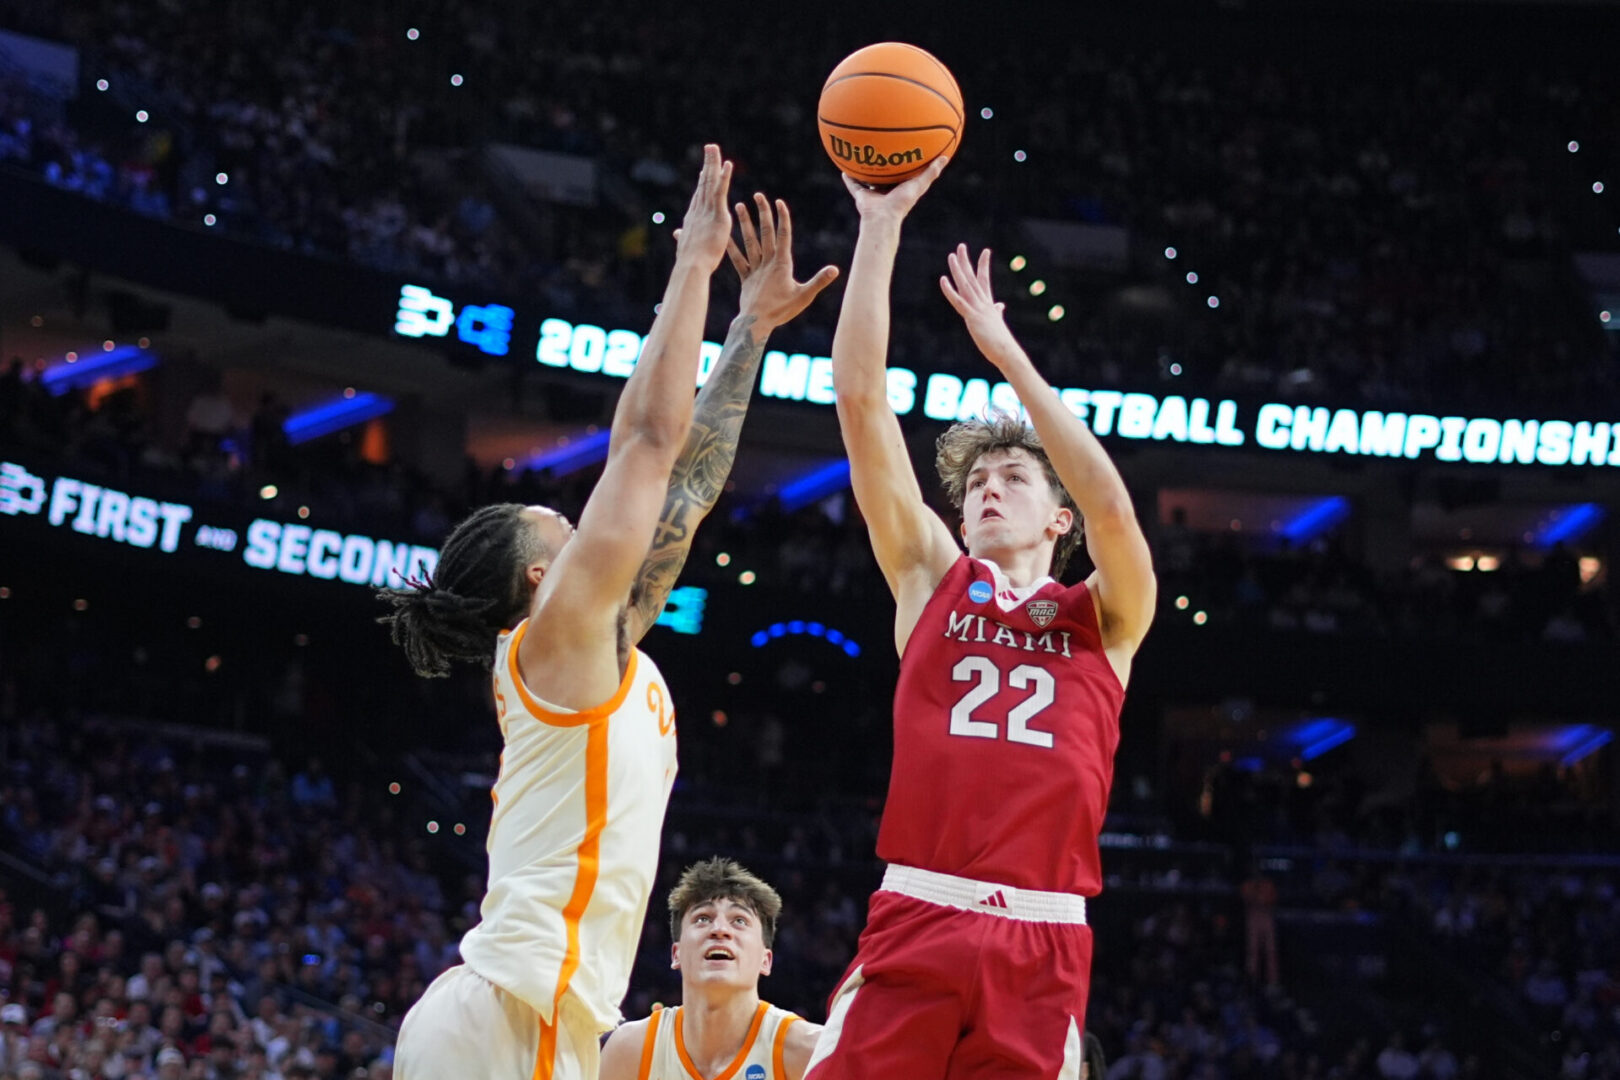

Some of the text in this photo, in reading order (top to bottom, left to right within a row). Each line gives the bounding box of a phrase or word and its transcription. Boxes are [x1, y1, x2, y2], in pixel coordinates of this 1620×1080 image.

[829, 133, 923, 167] Wilson
[536, 317, 650, 379] 202
[759, 350, 918, 415] MES
[924, 372, 1245, 446] BASETBALL
[48, 476, 193, 553] FIRST
[243, 518, 439, 591] SECOND
[944, 609, 1073, 659] MIAMI
[949, 655, 1056, 749] 22
